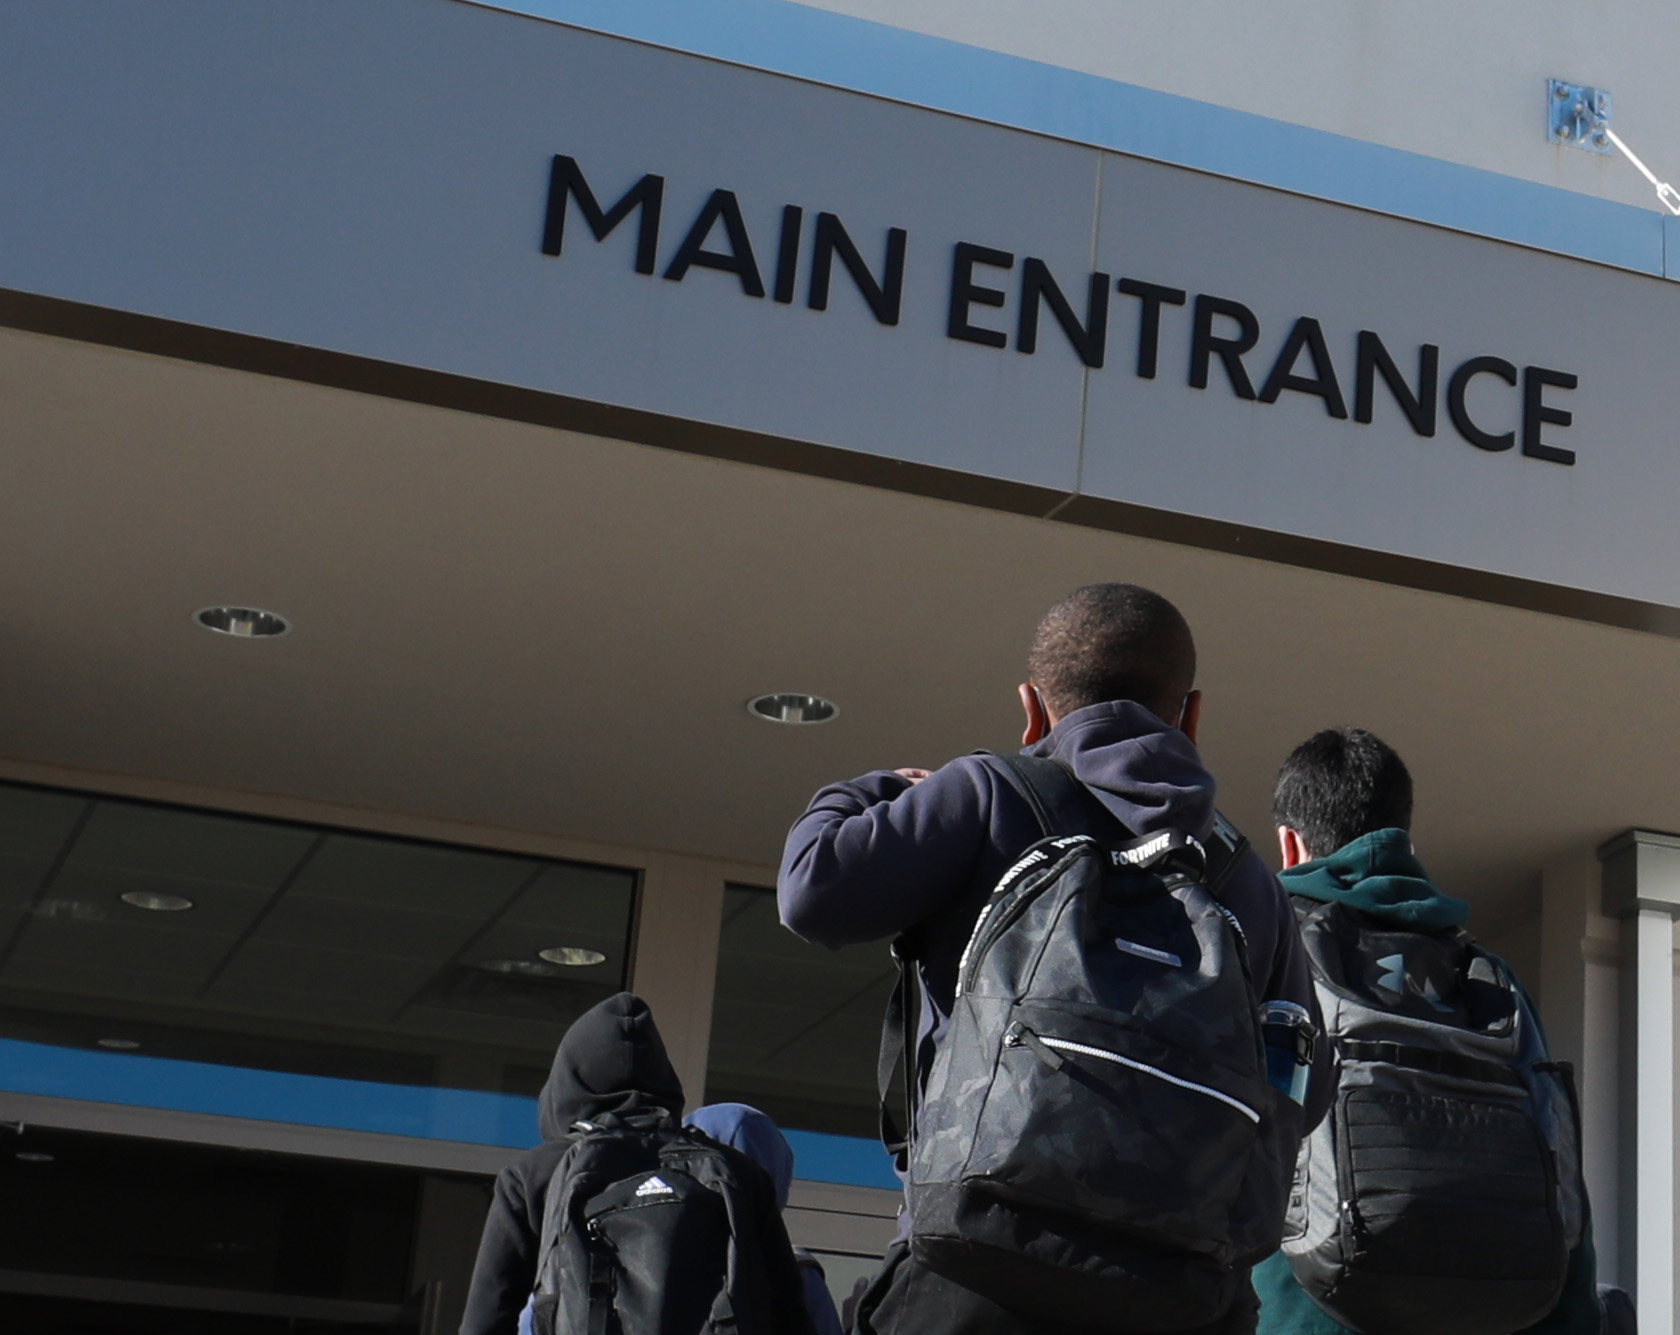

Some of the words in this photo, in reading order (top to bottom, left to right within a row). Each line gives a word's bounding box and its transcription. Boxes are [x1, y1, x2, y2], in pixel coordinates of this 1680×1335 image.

[542, 154, 907, 326] MAIN
[947, 241, 1578, 465] ENTRANCE
[1111, 833, 1170, 866] FORTNITE
